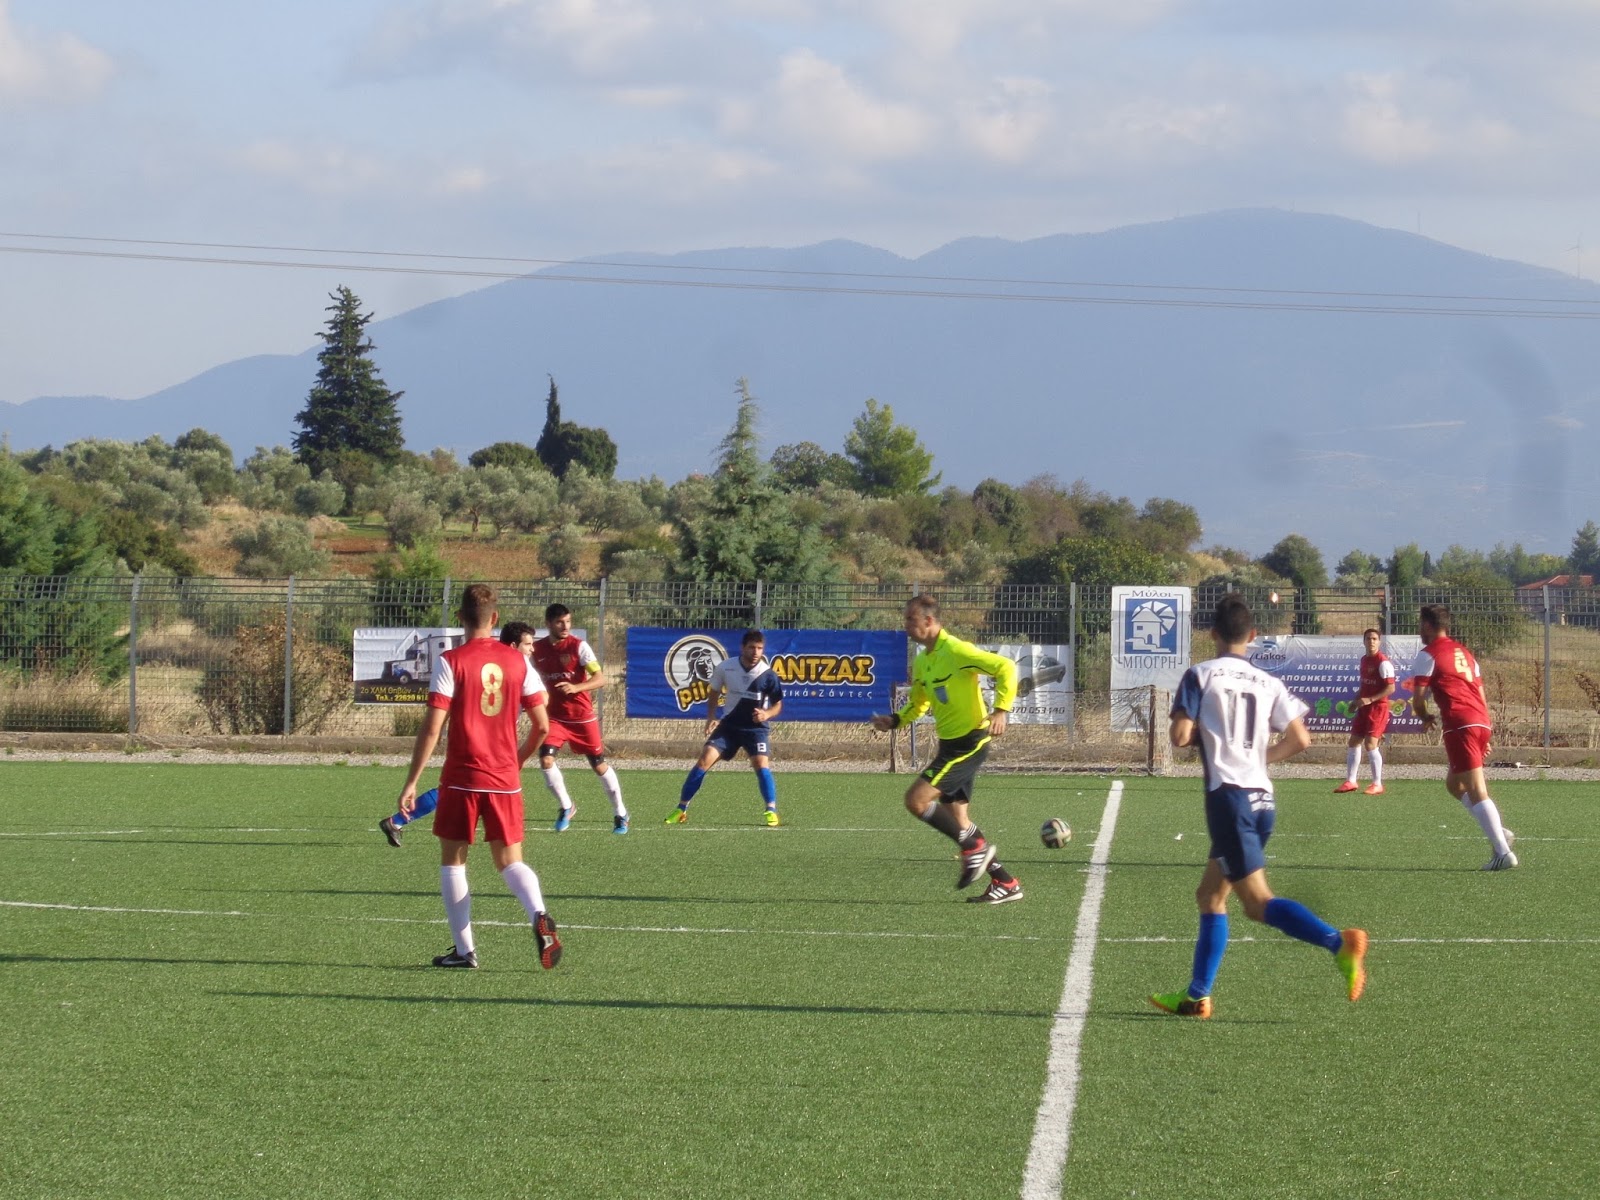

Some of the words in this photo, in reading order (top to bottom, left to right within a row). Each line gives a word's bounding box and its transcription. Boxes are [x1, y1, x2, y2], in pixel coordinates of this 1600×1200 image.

[1131, 589, 1171, 598] Μύλοι
[1123, 655, 1177, 669] ΜΠΟΓΡΗ
[1255, 652, 1286, 660] Liakos
[1454, 647, 1473, 683] 4
[771, 657, 872, 682] ΑΝΤΖΑΣ
[480, 662, 504, 717] 8
